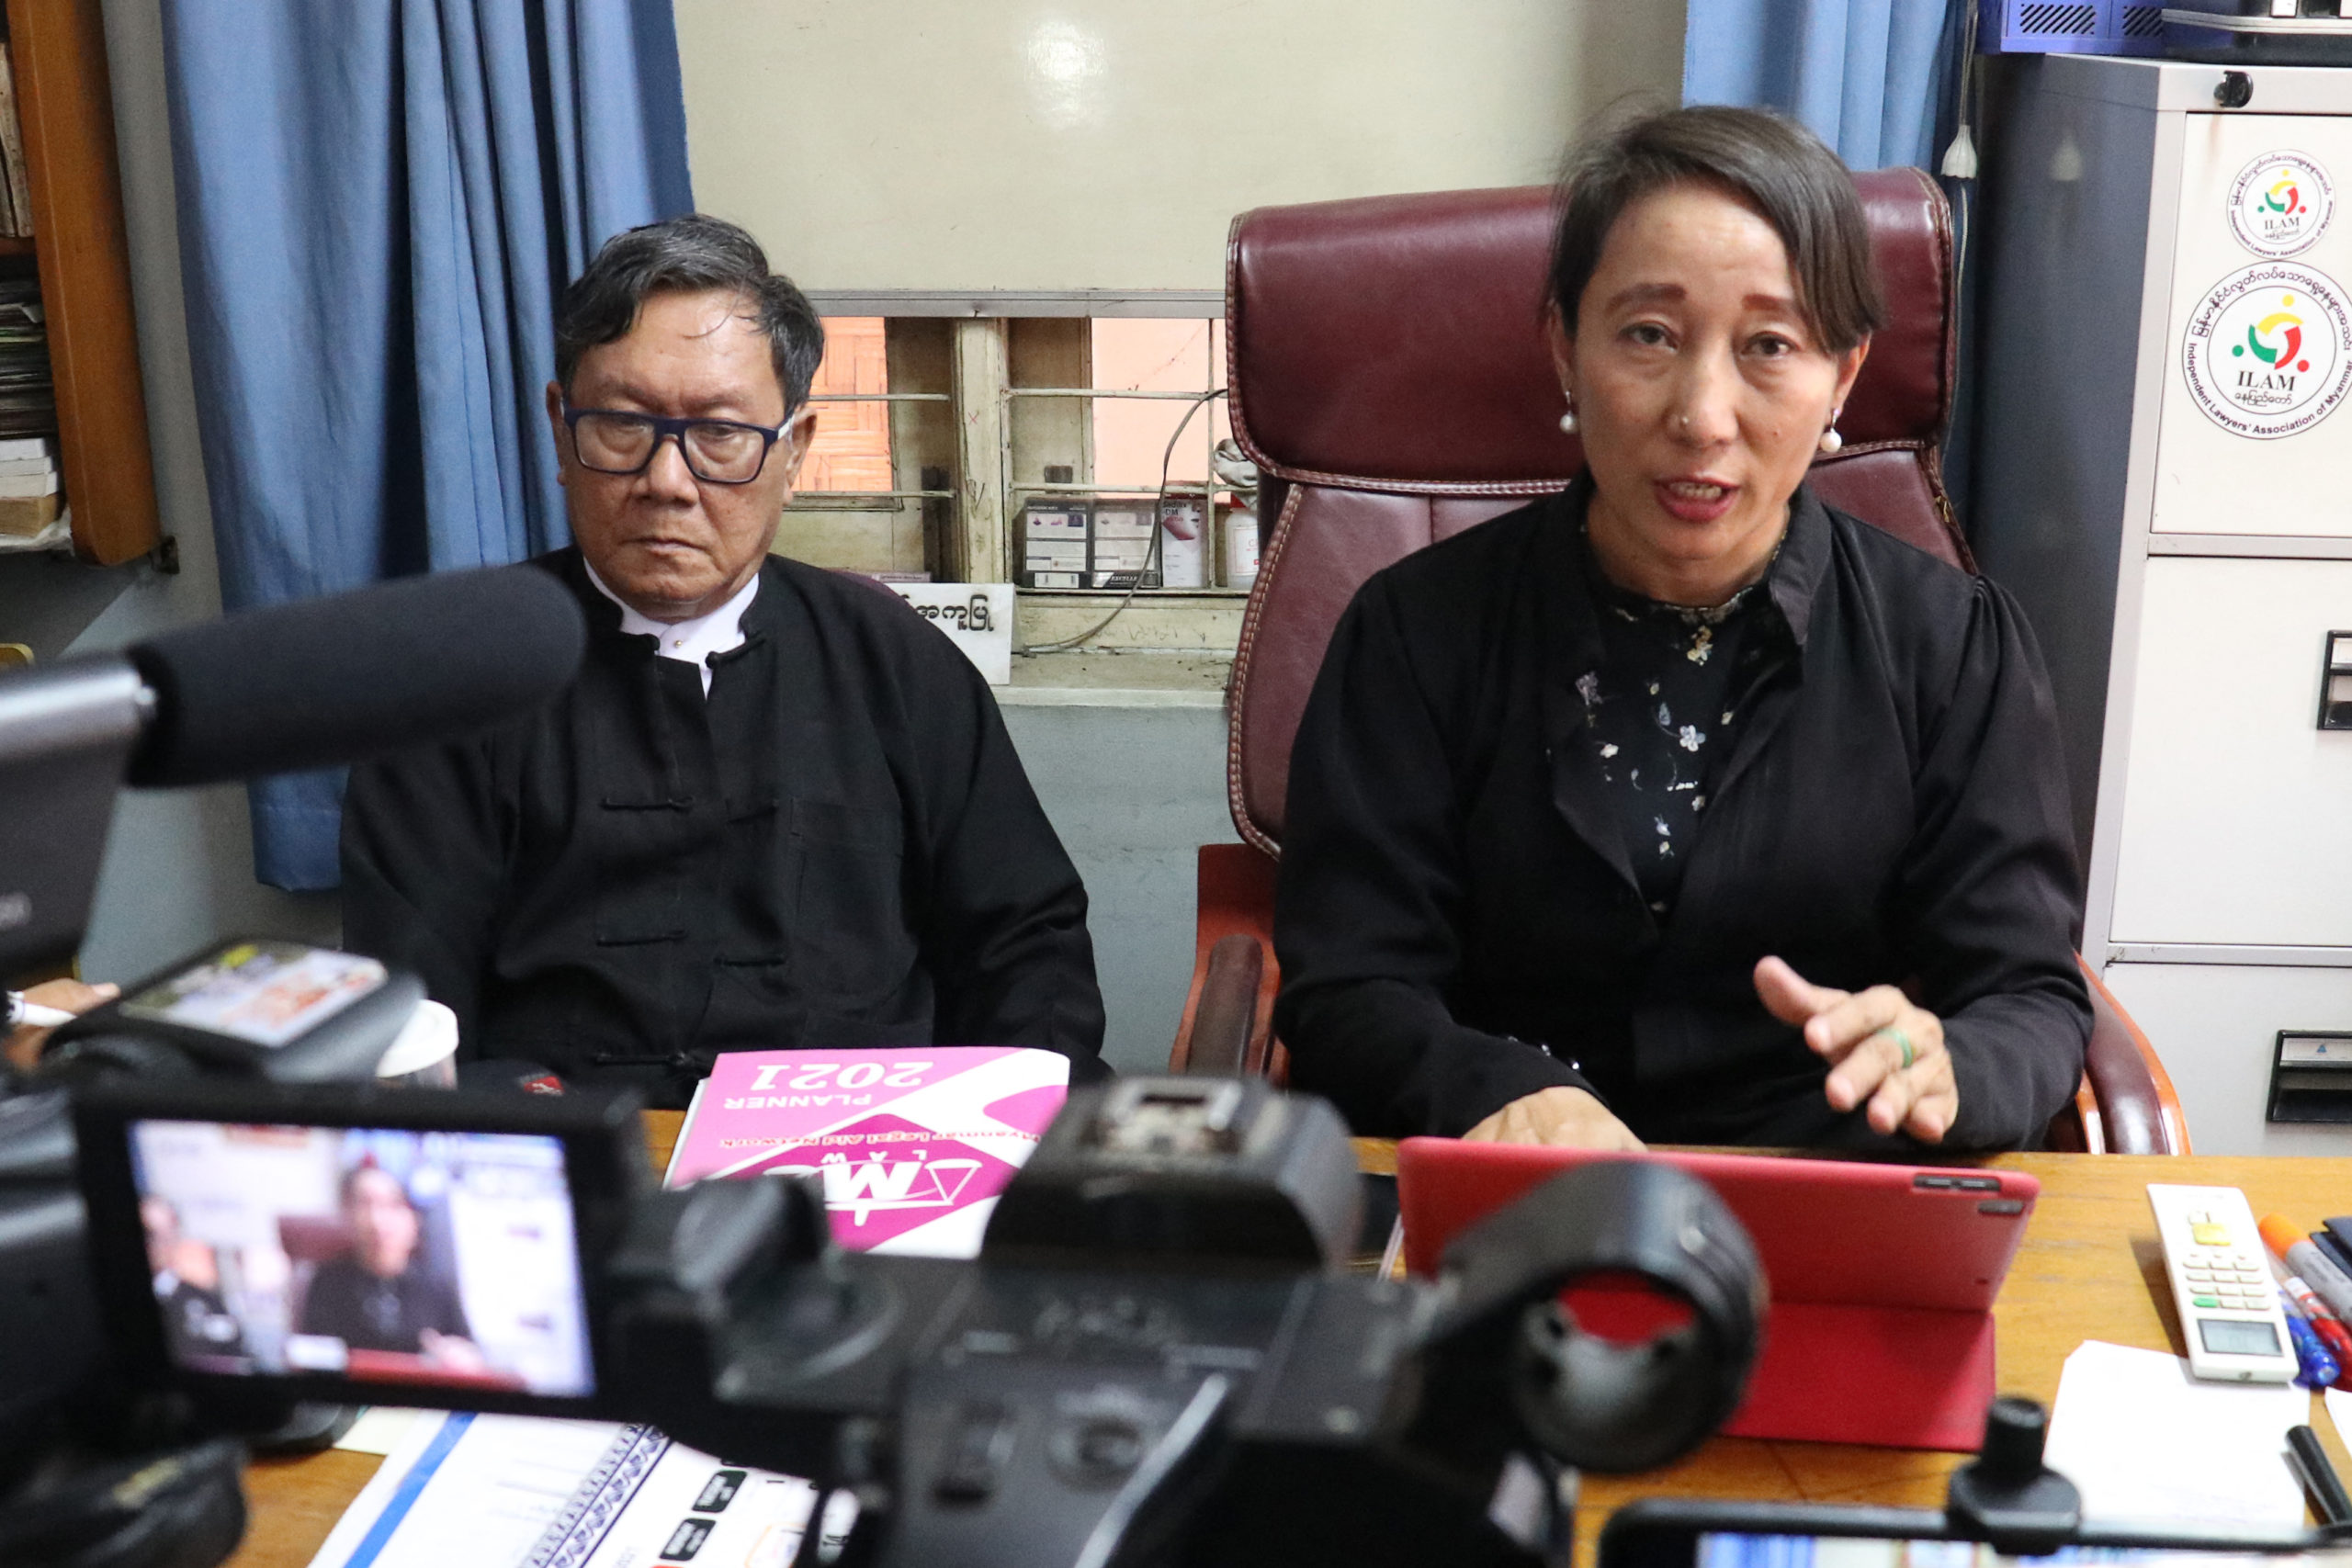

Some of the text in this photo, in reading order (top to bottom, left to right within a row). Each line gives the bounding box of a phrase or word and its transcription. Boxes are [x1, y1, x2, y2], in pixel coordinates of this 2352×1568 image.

[2264, 217, 2300, 230] ILAM
[2188, 343, 2352, 434] Independent Lawyers' Association of Myanmar
[2237, 370, 2296, 391] ILAM
[750, 1061, 934, 1091] 2021
[723, 1093, 873, 1110] PLANNER
[718, 1130, 1040, 1148] Myanmar Legal Aid Network
